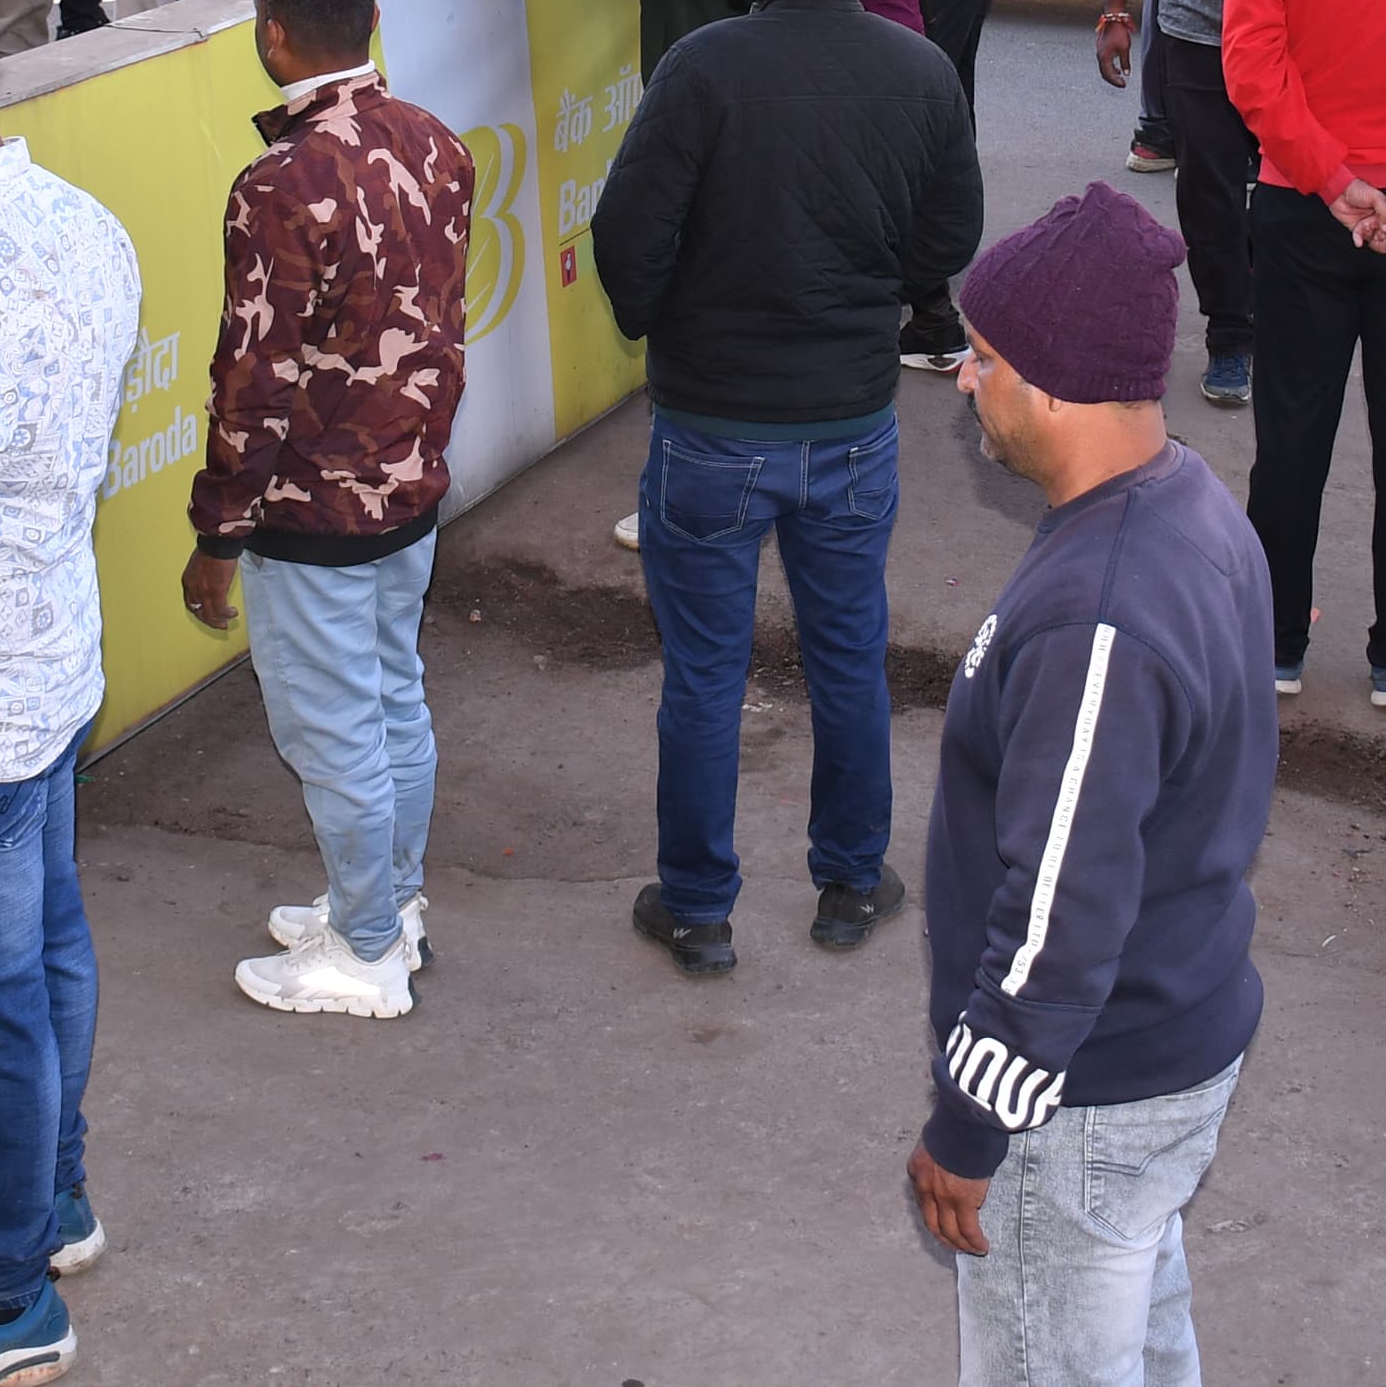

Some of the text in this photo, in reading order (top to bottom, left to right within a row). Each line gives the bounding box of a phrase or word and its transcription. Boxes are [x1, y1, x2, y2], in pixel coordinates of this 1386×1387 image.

[554, 88, 594, 152] बैंक
[558, 157, 613, 236] Ban
[120, 325, 181, 414] ड़ौदा
[101, 405, 198, 501] Baroda
